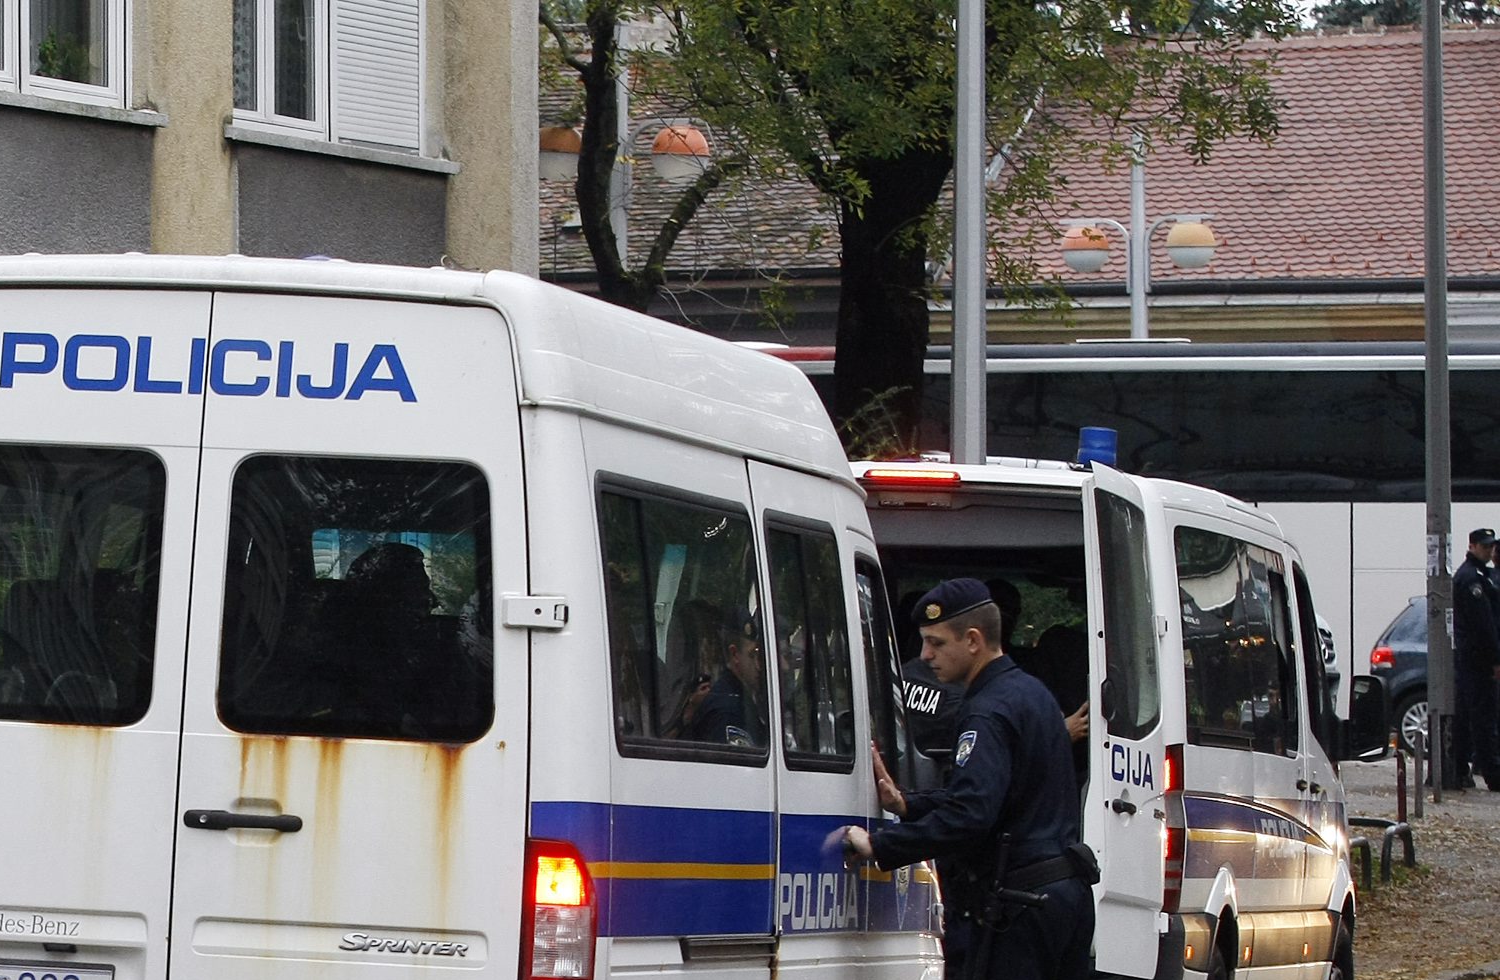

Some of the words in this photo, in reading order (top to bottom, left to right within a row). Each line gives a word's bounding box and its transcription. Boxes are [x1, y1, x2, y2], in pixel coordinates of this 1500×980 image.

[0, 332, 416, 402] POLICIJA
[1111, 744, 1154, 791] CIJA
[779, 872, 859, 931] POLICIJA
